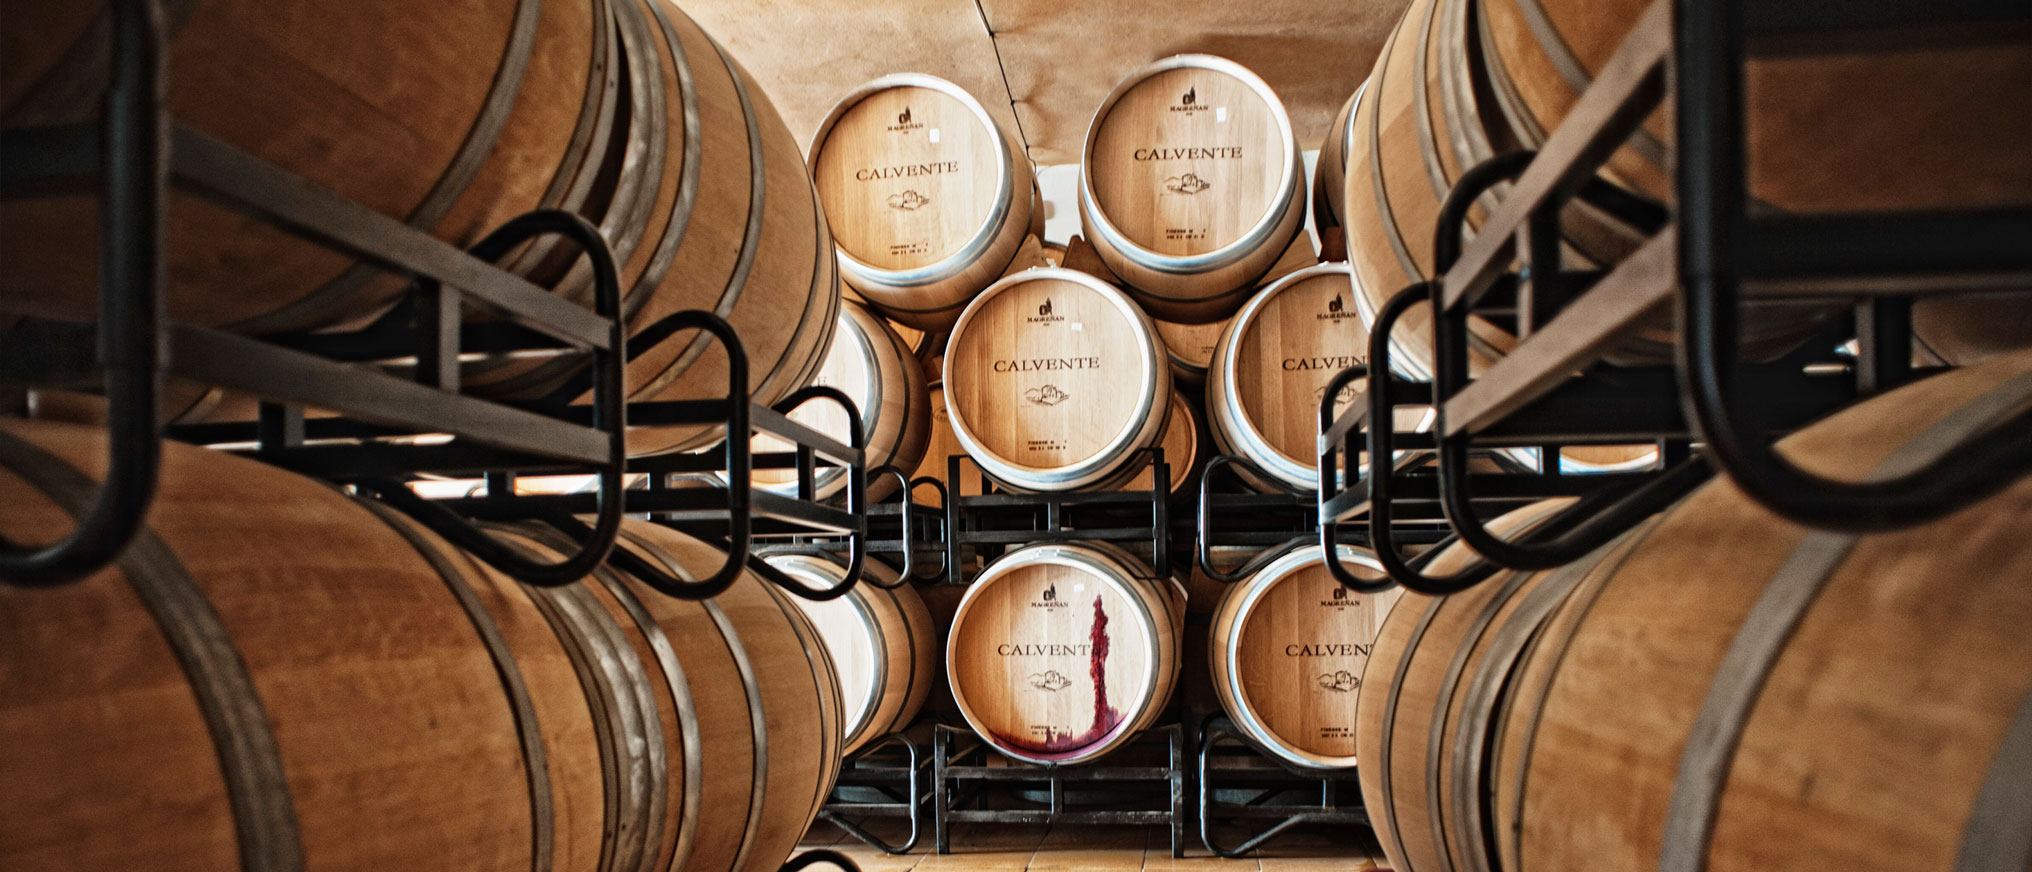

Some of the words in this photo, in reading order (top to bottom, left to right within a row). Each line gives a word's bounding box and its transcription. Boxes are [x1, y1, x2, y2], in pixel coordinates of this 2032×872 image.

[1134, 146, 1243, 161] CALVENTE
[856, 161, 959, 182] CALVENTE
[994, 356, 1100, 373] CALVENTE
[1282, 355, 1367, 371] CALVEN
[997, 643, 1092, 657] CALVENT
[1285, 643, 1374, 657] CALVEN
